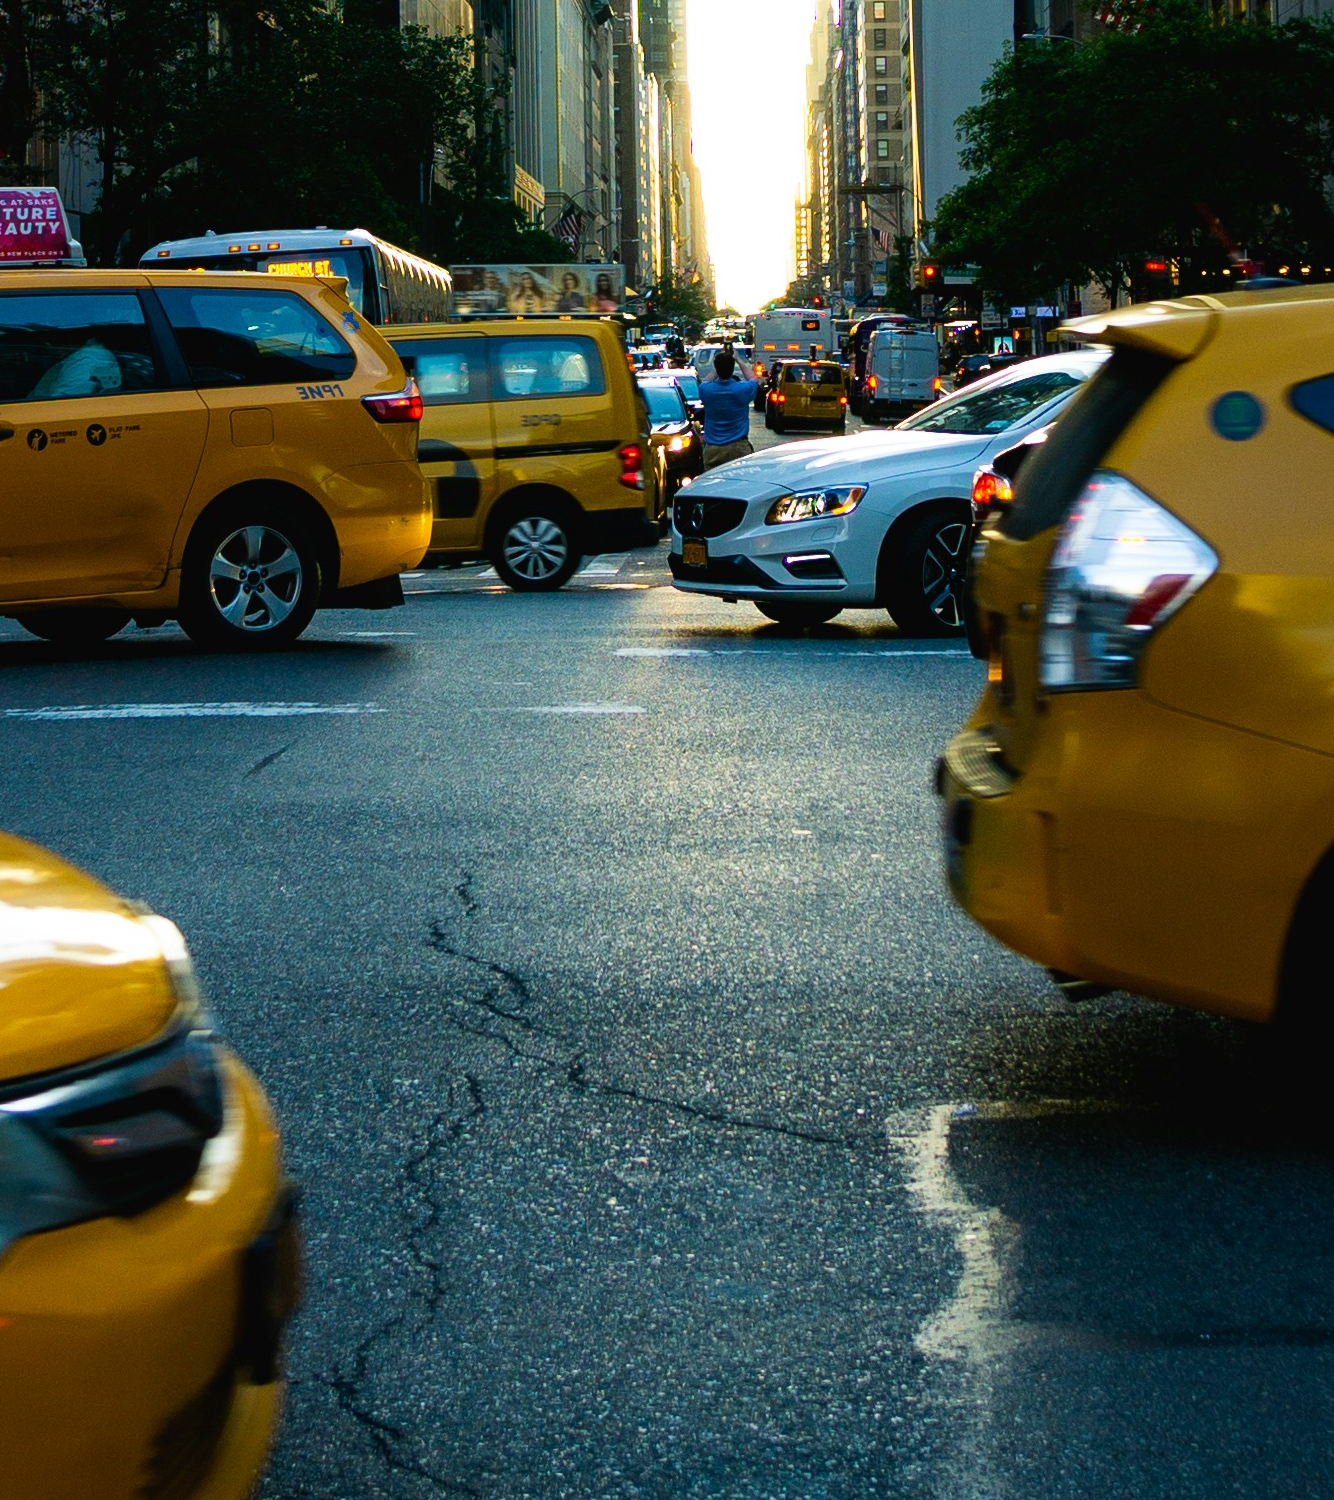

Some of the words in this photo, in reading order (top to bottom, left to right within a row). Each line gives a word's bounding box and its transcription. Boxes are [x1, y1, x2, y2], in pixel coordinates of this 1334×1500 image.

[27, 198, 55, 206] SAKS
[268, 262, 313, 277] CHURCH
[296, 383, 344, 400] 3N91
